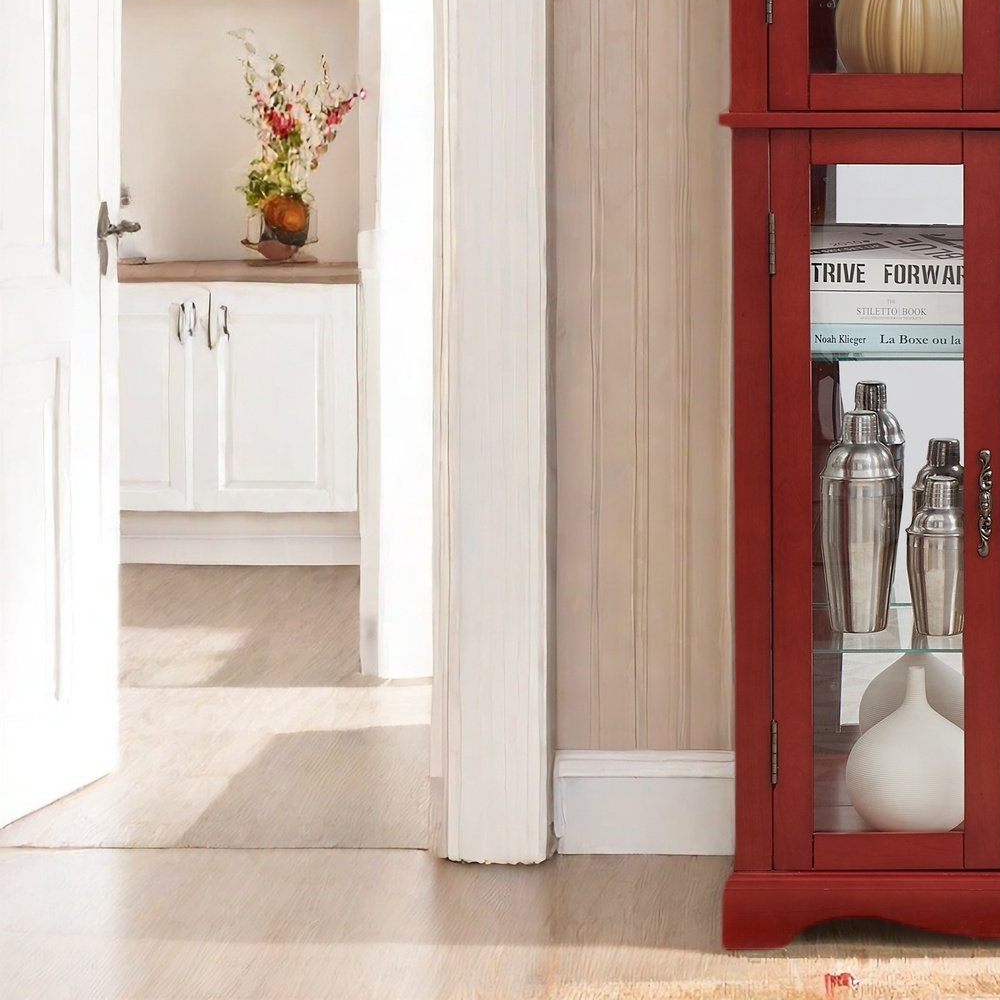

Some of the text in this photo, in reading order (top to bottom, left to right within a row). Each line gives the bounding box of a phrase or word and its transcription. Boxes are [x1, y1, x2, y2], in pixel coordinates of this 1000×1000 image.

[811, 262, 866, 284] TRIVE
[856, 307, 927, 316] STILETTO BOOK
[814, 334, 867, 346] Noah Klieger
[880, 334, 961, 345] La Boxe ou la
